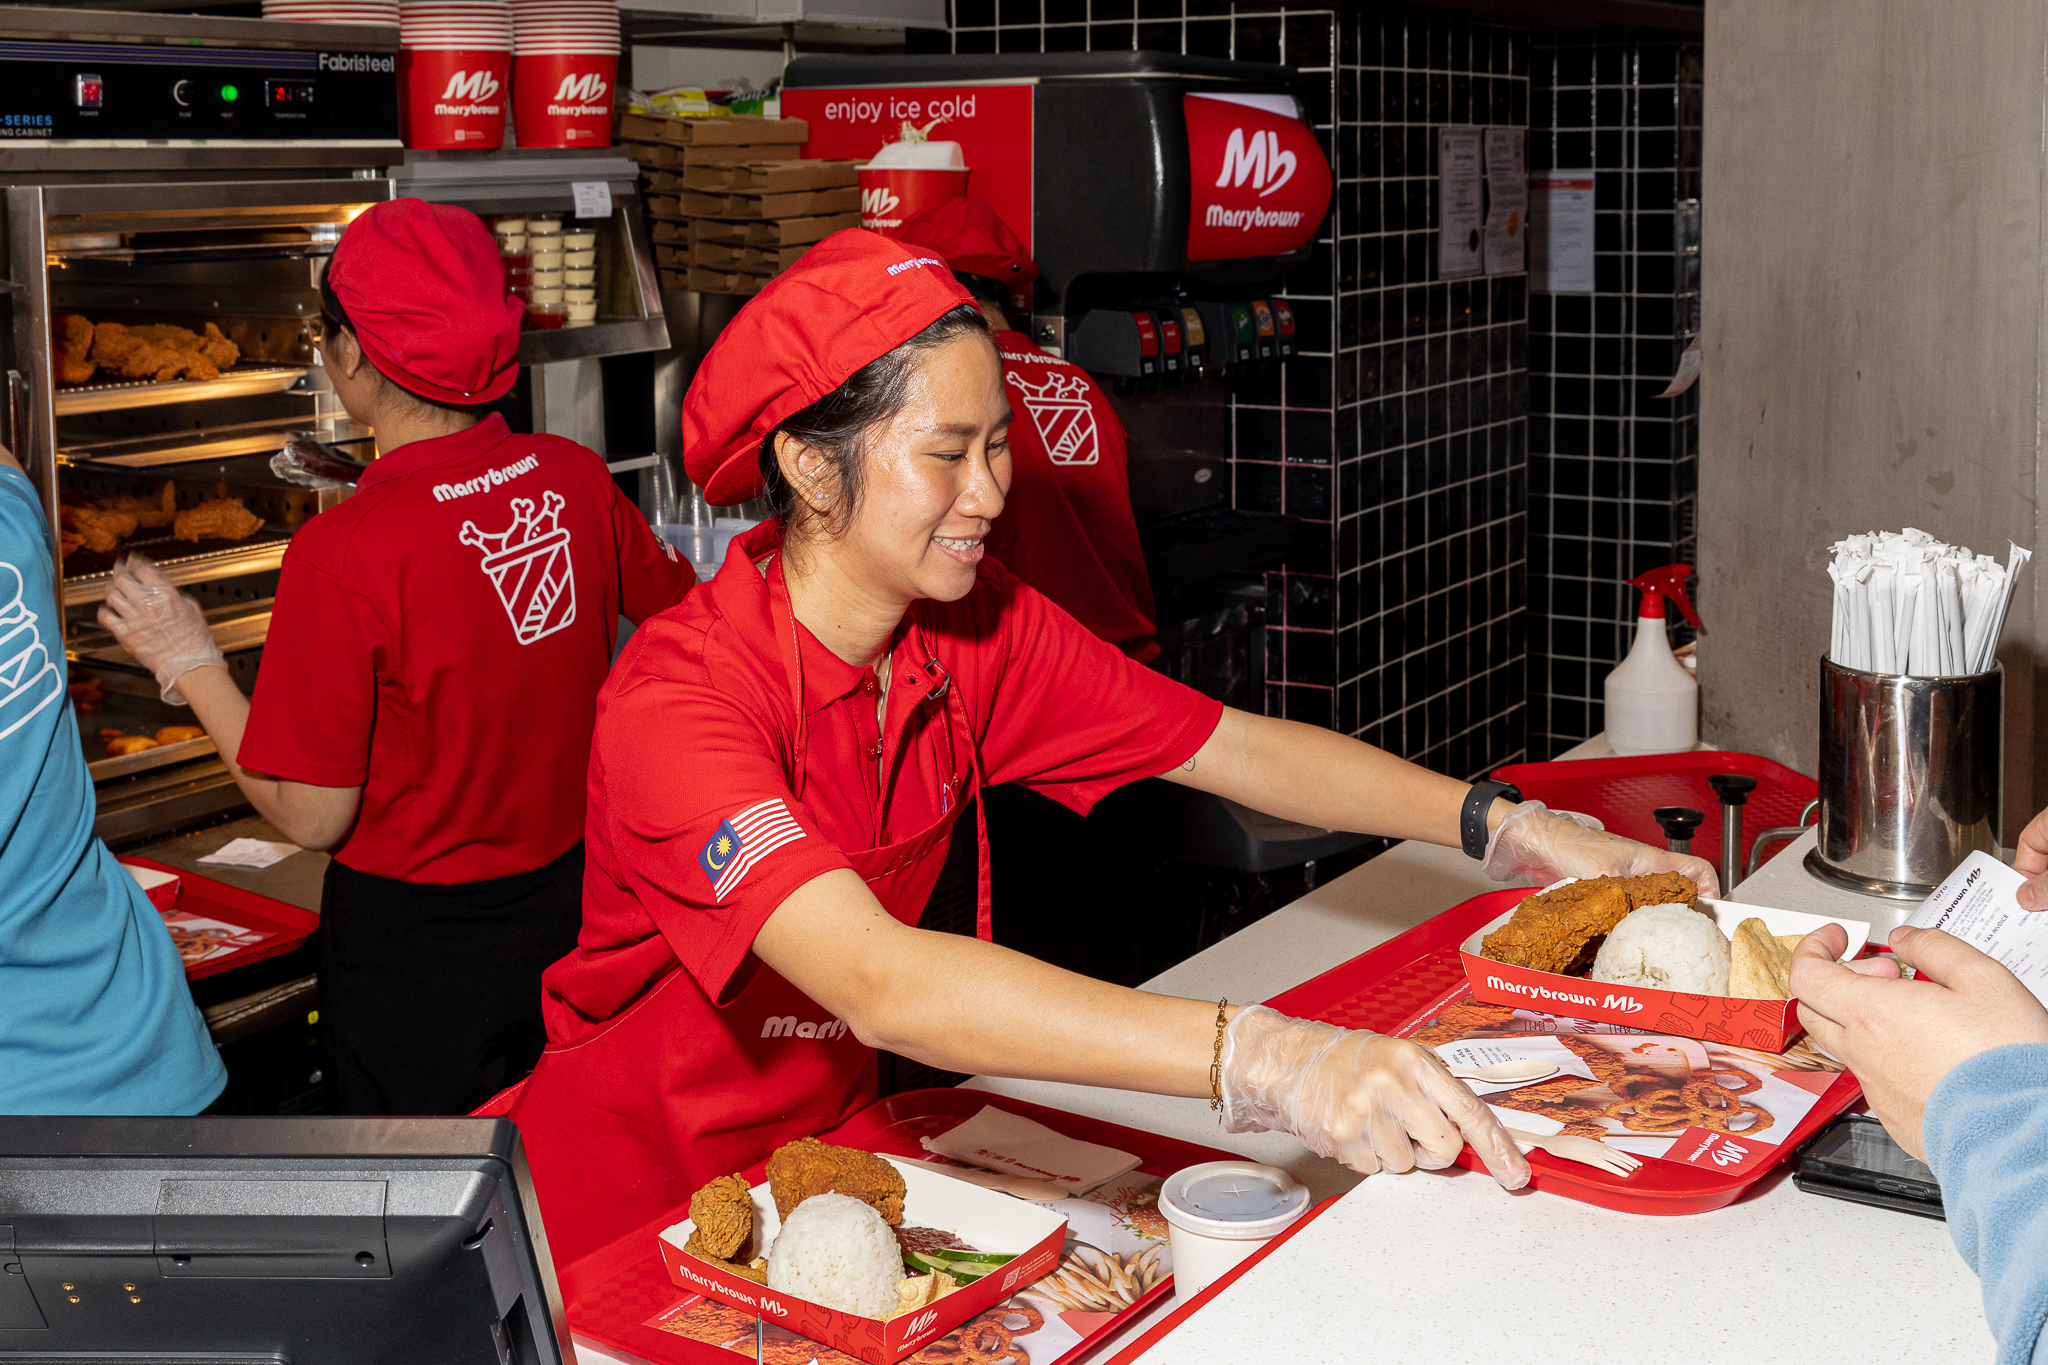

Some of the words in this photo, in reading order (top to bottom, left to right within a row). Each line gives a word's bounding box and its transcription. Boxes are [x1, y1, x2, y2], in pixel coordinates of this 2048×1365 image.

[318, 53, 395, 72] Fabristeel
[0, 114, 53, 126] -SERIES
[825, 97, 883, 123] enjoy
[890, 95, 921, 119] ice
[927, 95, 976, 118] cold
[0, 128, 14, 137] ING
[15, 128, 53, 137] CABINET
[1215, 128, 1297, 197] Mb
[1205, 205, 1301, 232] Marrybrown
[432, 454, 539, 502] Marrybrown
[1935, 888, 1968, 929] arrybrown
[1486, 975, 1597, 1007] Marrybrown
[1602, 994, 1644, 1014] Mb
[760, 1016, 848, 1041] Marry
[679, 1265, 757, 1307] Marrybrown
[760, 1297, 788, 1317] Mb
[903, 1309, 938, 1340] Mb
[897, 1327, 937, 1353] Marrybrown
